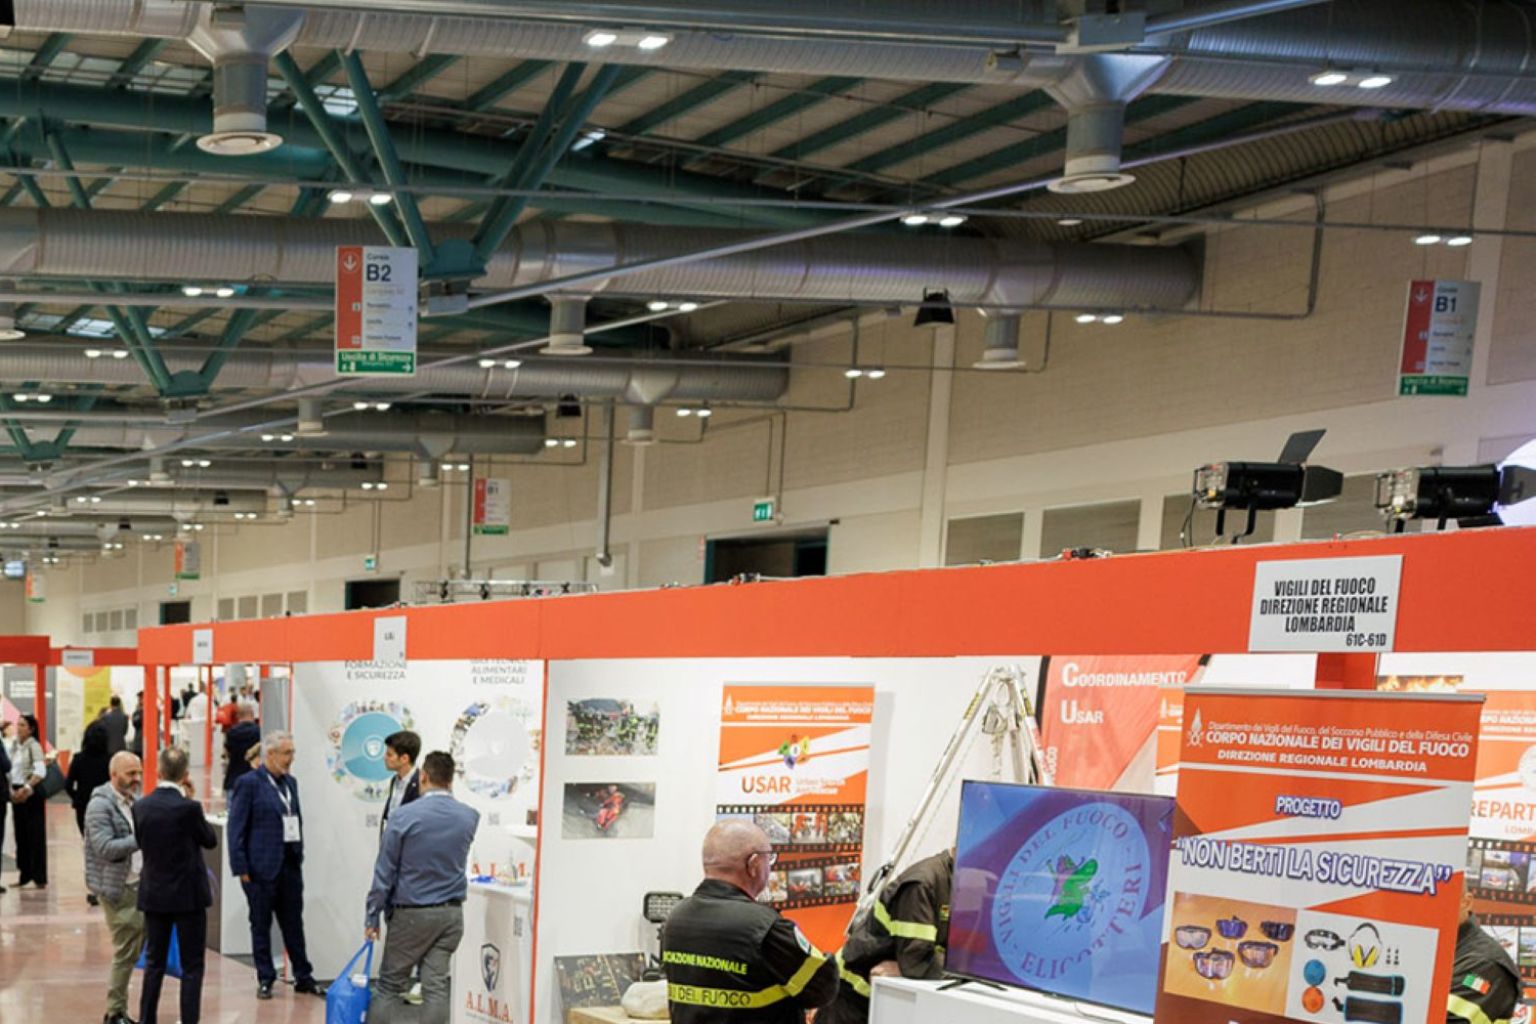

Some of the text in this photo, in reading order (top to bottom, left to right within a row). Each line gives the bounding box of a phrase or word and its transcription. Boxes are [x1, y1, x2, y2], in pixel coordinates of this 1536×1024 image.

[366, 264, 392, 282] B2
[1435, 296, 1457, 313] B1
[1274, 577, 1376, 596] VIGILI DEL FUOCO
[1260, 596, 1388, 615] DIREZIONE REGIONALE
[1285, 616, 1355, 633] LOMBARDIA
[1346, 633, 1387, 647] 61C-61D
[355, 670, 406, 680] SICUREZZA
[471, 666, 527, 674] ALIMENTARI
[480, 676, 524, 685] MEDICALI
[1206, 731, 1469, 757] CORPO NAZIONALE DEI VIGILI DEL FUOCO
[1217, 749, 1427, 772] DIREZIONE REGIONALE LOMBARDIA
[741, 776, 791, 794] USAR
[1275, 796, 1342, 818] PROGETTO
[1063, 809, 1129, 839] FUOCO
[1228, 842, 1288, 878] BERTI
[1287, 846, 1315, 880] LA
[697, 954, 748, 975] NAZIONALE
[678, 987, 699, 1002] DEL
[702, 990, 751, 1006] FUOCO
